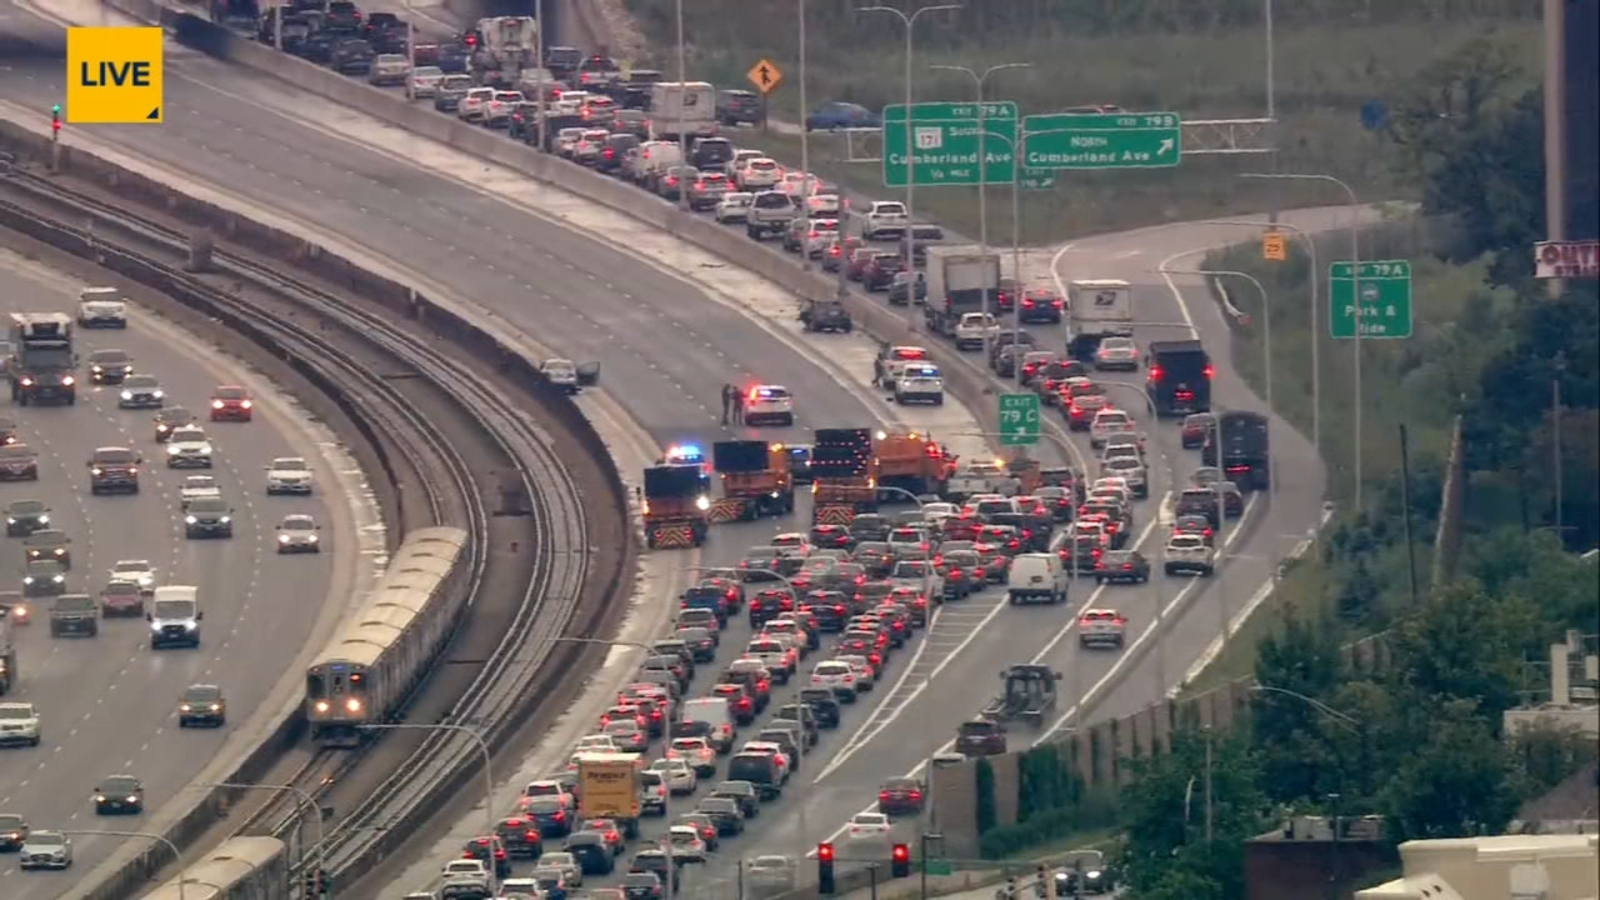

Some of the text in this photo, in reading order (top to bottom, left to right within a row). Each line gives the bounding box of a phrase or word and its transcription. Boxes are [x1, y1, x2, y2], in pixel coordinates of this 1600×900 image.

[920, 134, 940, 146] 171
[1070, 135, 1108, 148] NORTH
[889, 151, 1013, 165] Cumberland Ave
[1029, 149, 1150, 163] Cumberland Ave
[1004, 398, 1031, 407] EXIT
